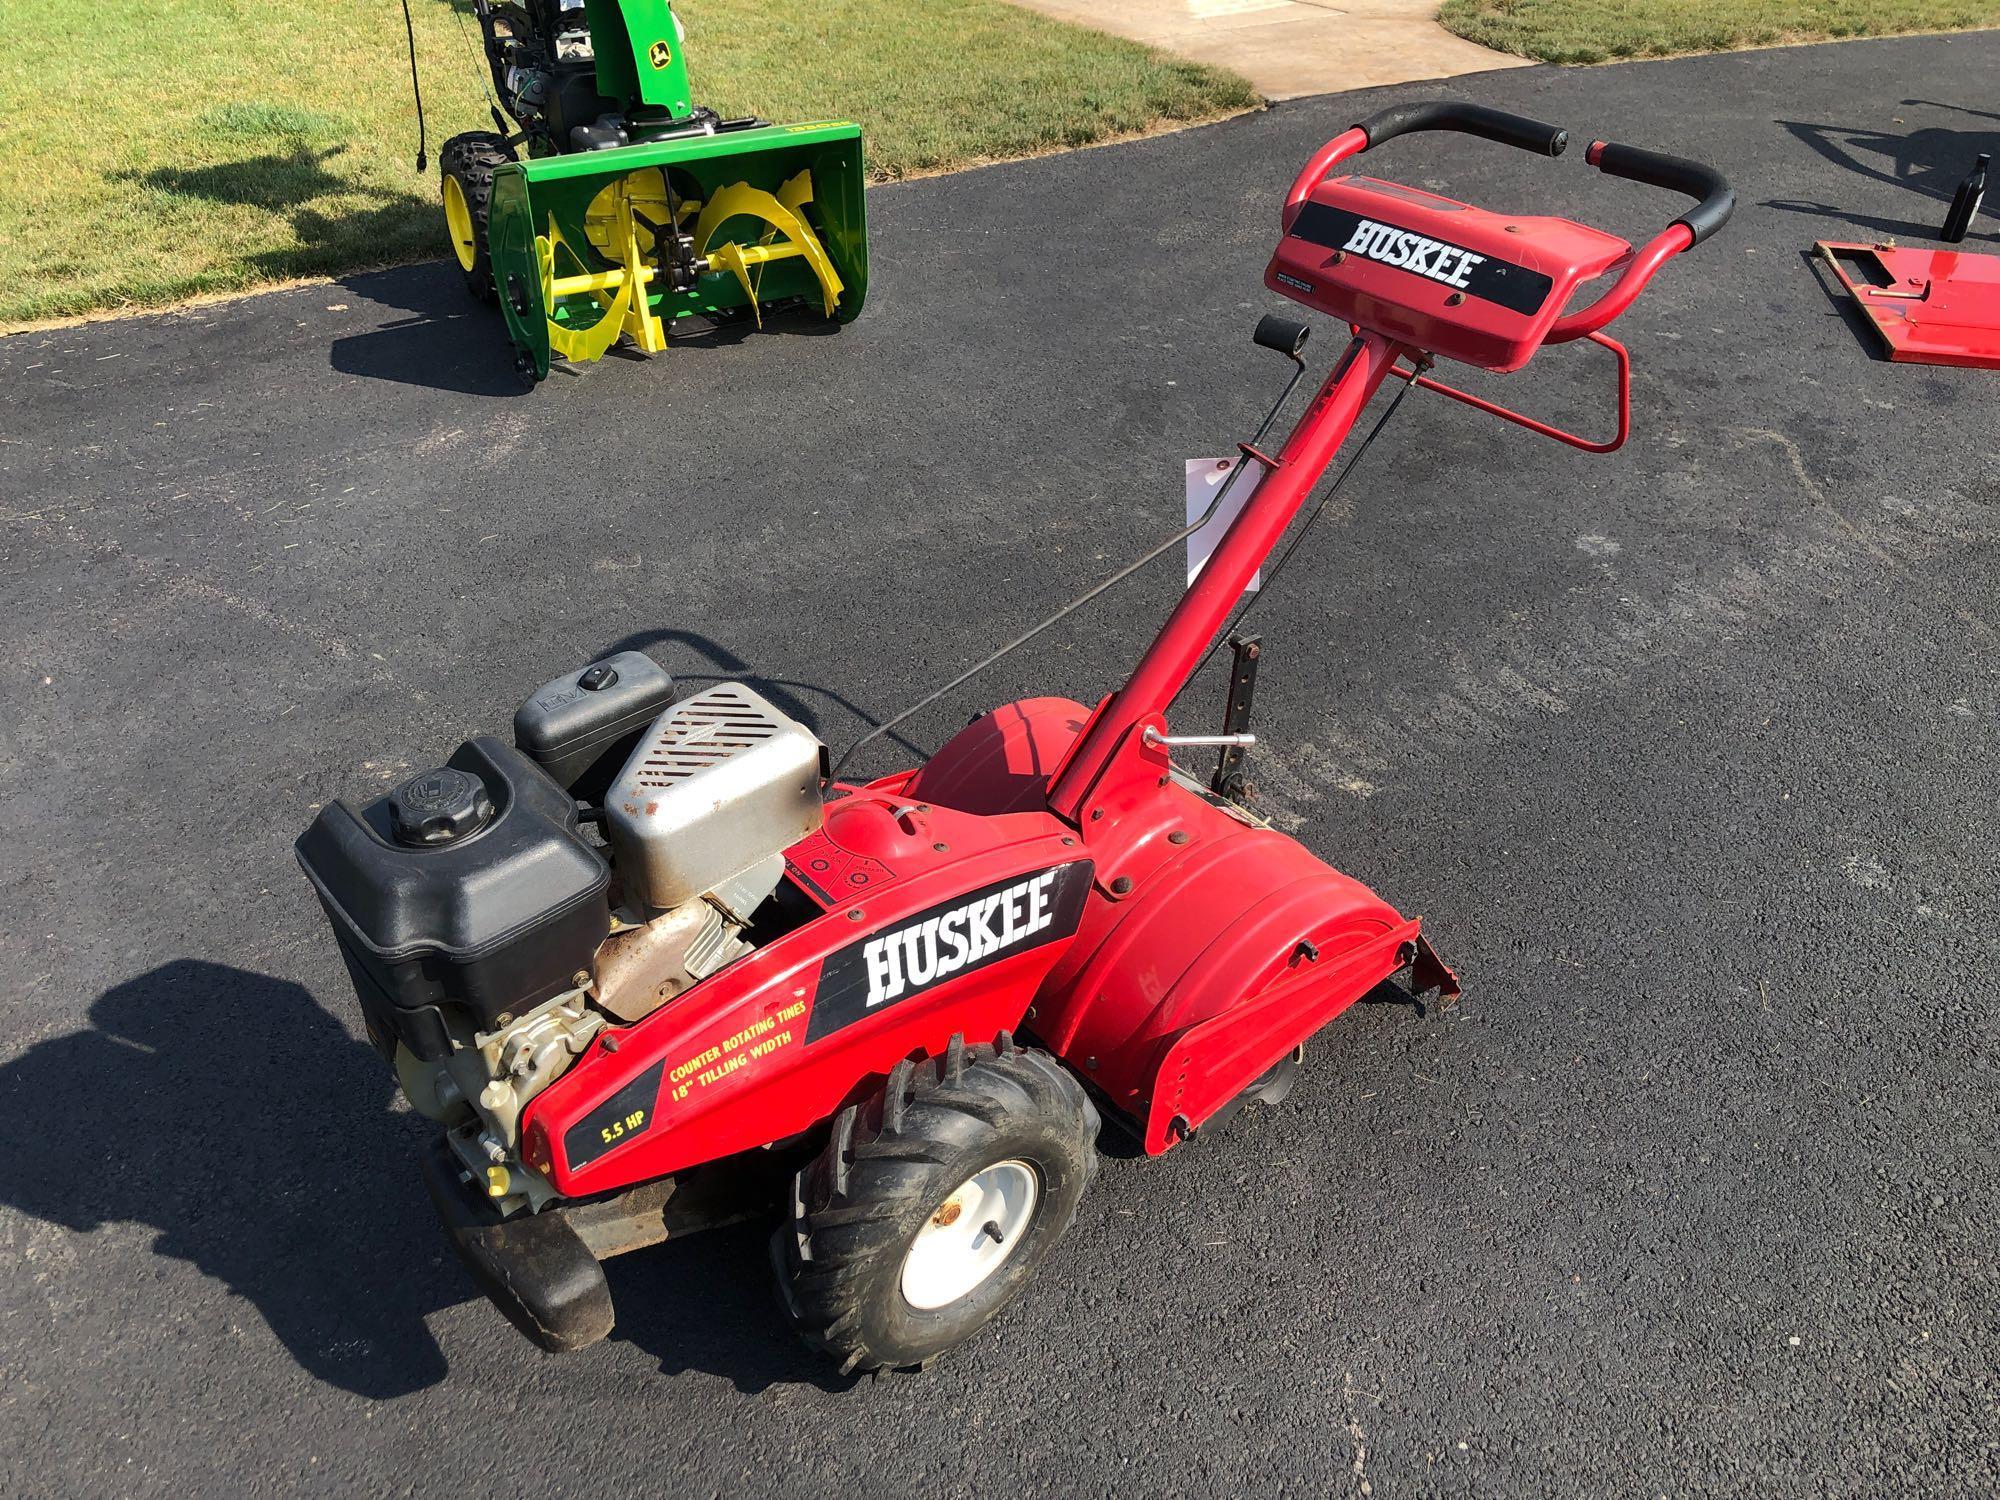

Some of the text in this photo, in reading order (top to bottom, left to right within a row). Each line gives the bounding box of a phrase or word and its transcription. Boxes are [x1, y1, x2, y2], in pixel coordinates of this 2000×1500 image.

[1342, 219, 1485, 289] HUSKEE
[863, 870, 1058, 1008] HUSKEE
[669, 1000, 807, 1083] COUNTER ROTATING TINES
[698, 1053, 748, 1087] TILLING
[750, 1030, 792, 1060] WIDTH
[601, 1110, 645, 1144] 5.5 HP
